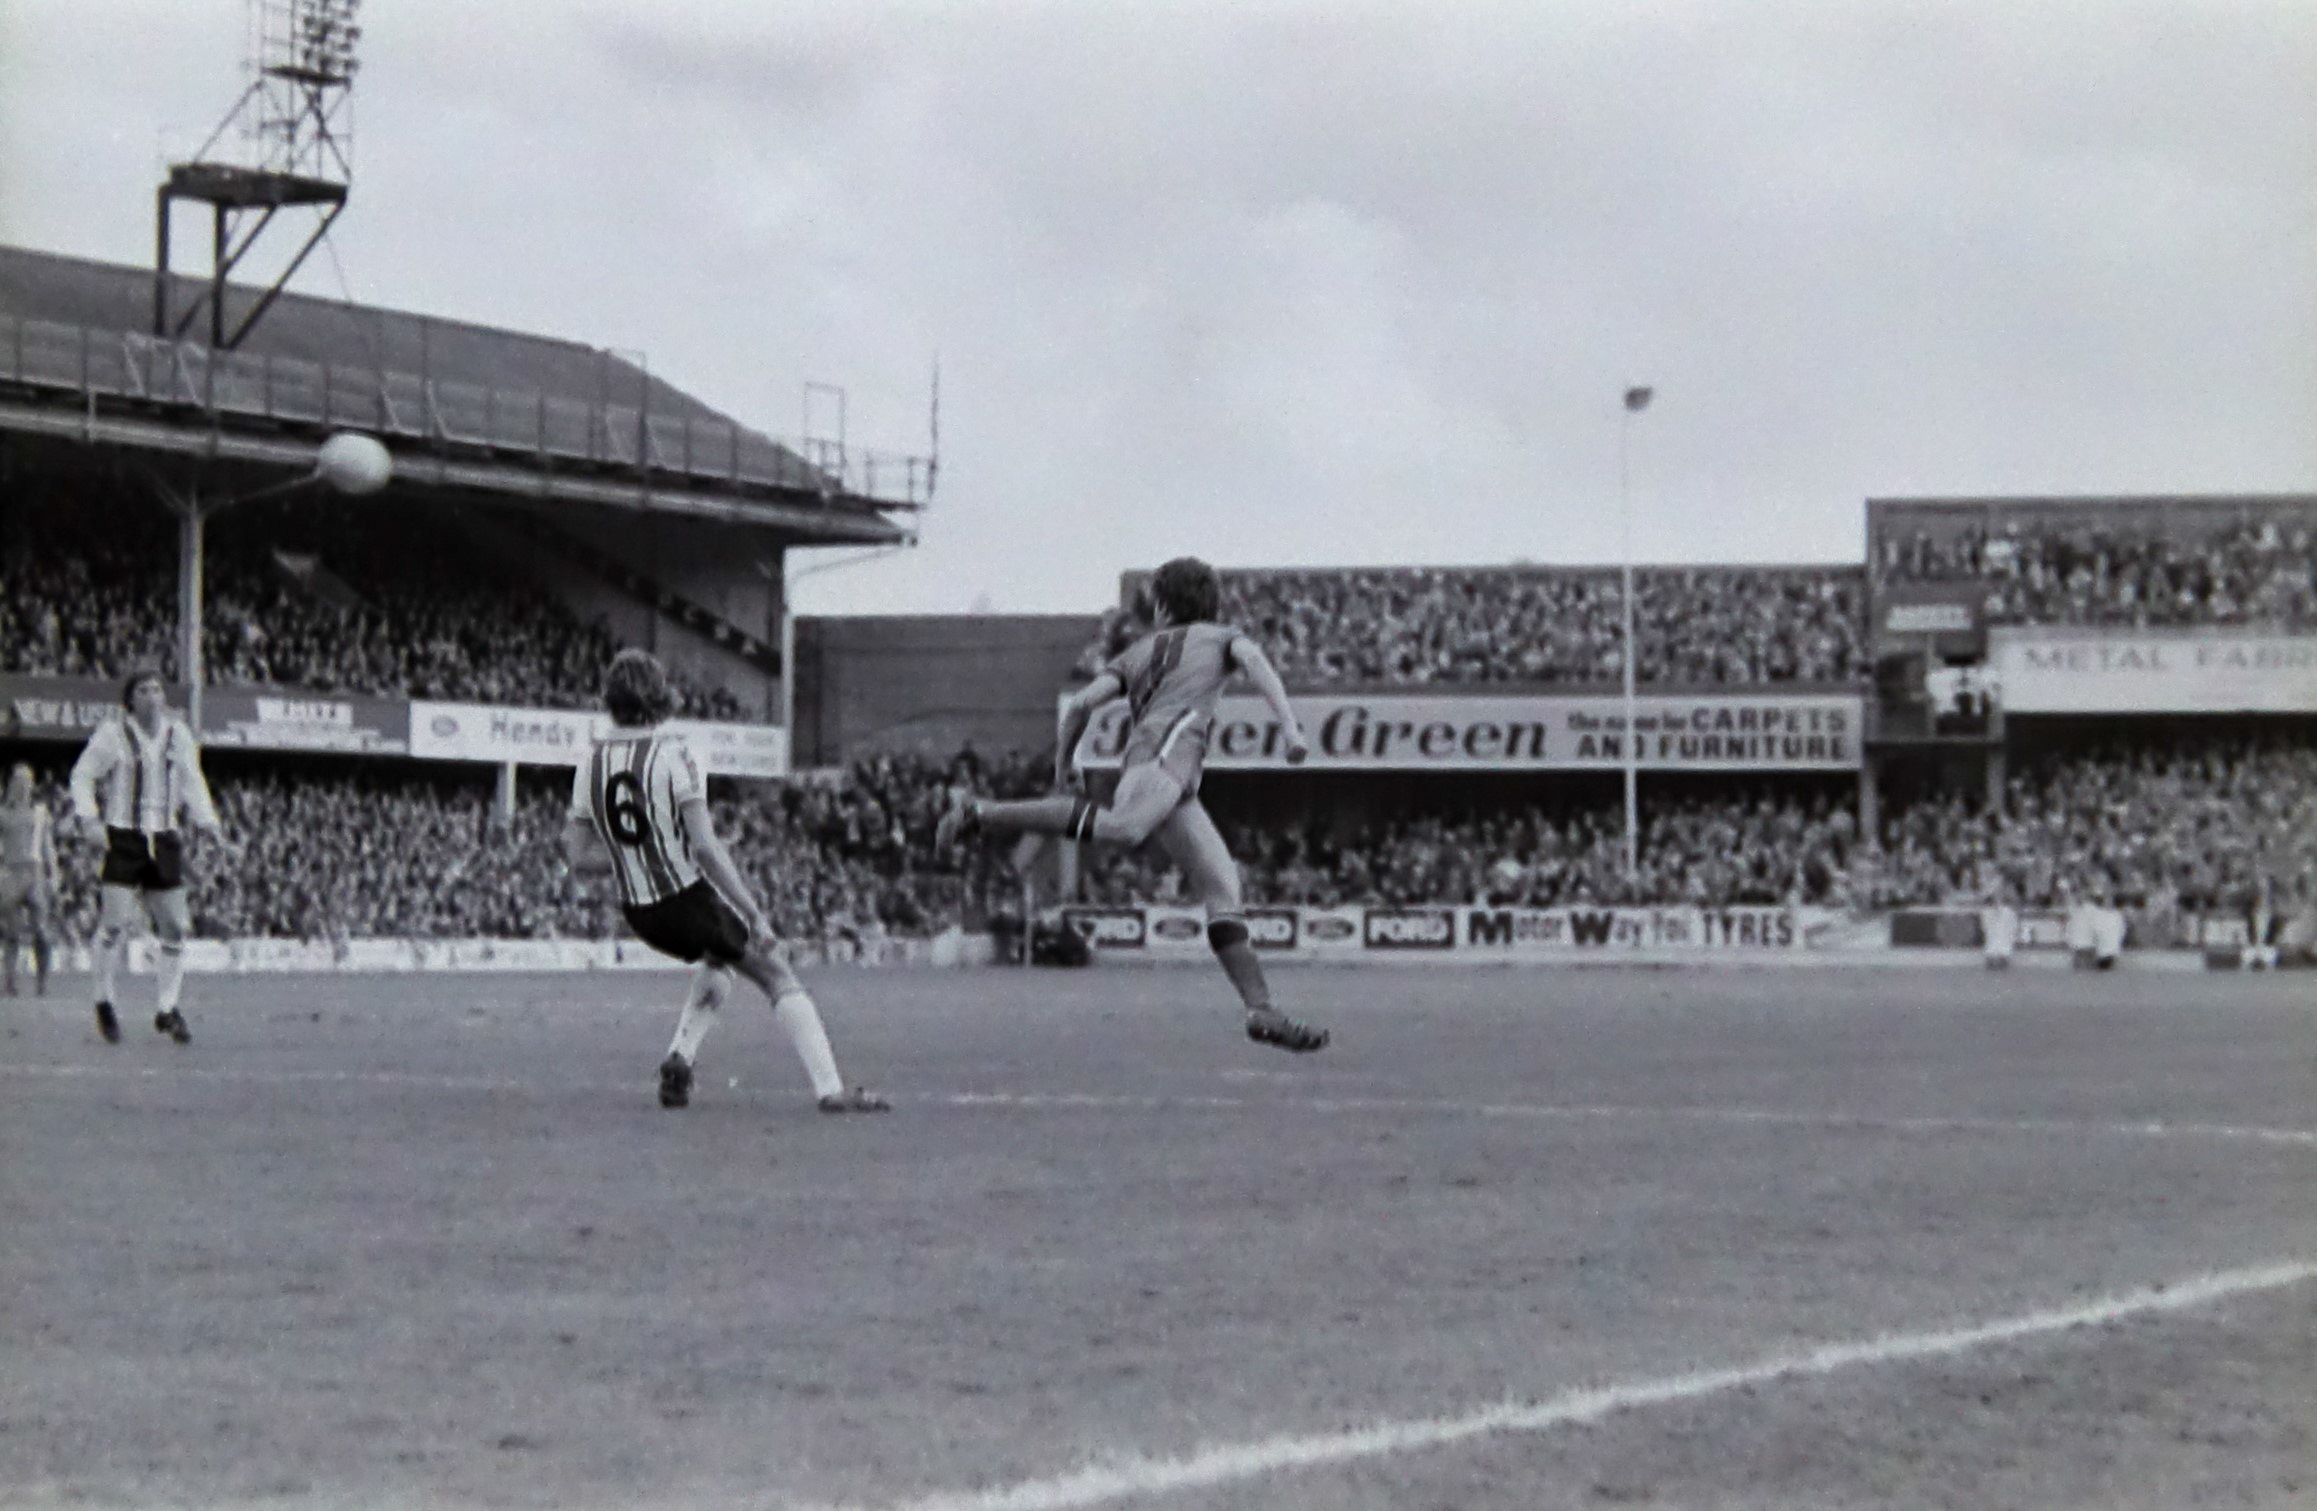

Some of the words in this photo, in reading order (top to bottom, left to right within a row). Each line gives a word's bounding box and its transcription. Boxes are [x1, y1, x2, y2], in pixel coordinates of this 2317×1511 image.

[1318, 704, 1547, 758] Green
[1690, 706, 1847, 733] CARPETS
[1657, 733, 1847, 760] FURNITURE
[605, 770, 650, 847] 6
[1702, 910, 1793, 946] TYRES
